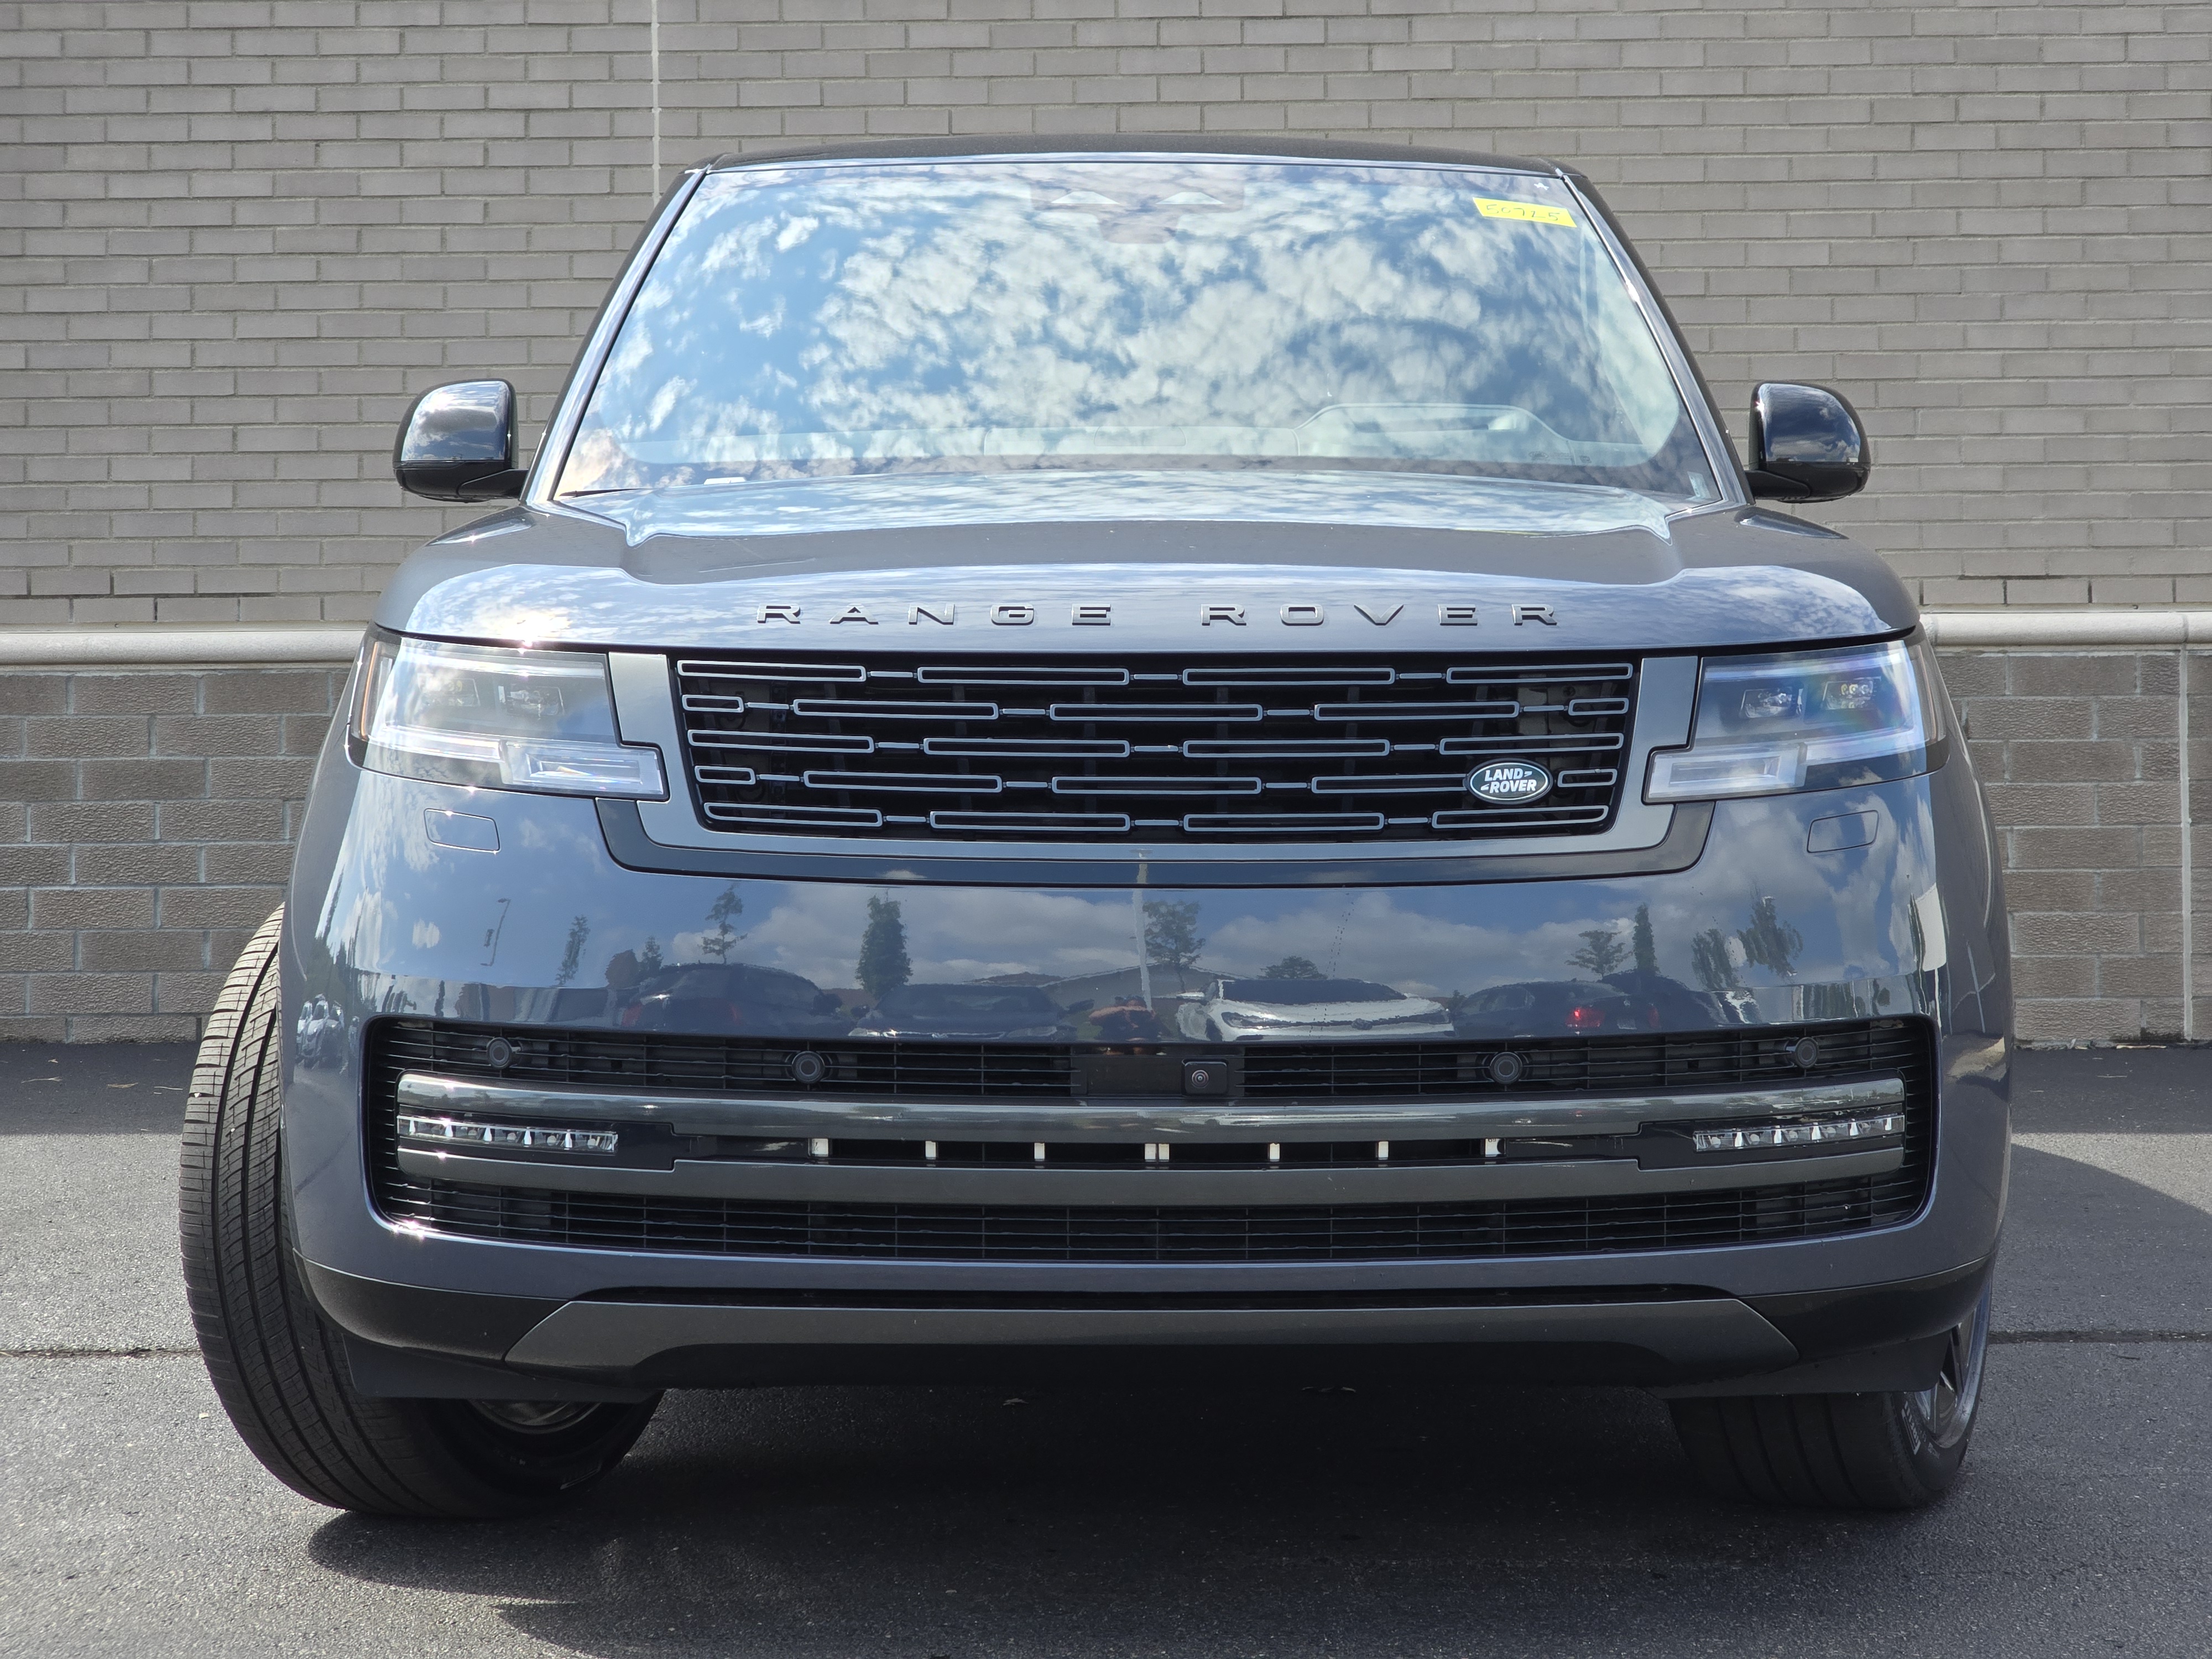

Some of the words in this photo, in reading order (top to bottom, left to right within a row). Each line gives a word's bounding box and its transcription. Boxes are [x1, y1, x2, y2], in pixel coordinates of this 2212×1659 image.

[757, 603, 1112, 625] RANGE
[1201, 603, 1558, 626] ROVER
[1484, 768, 1523, 781] LAND
[1489, 779, 1537, 793] ROVER
